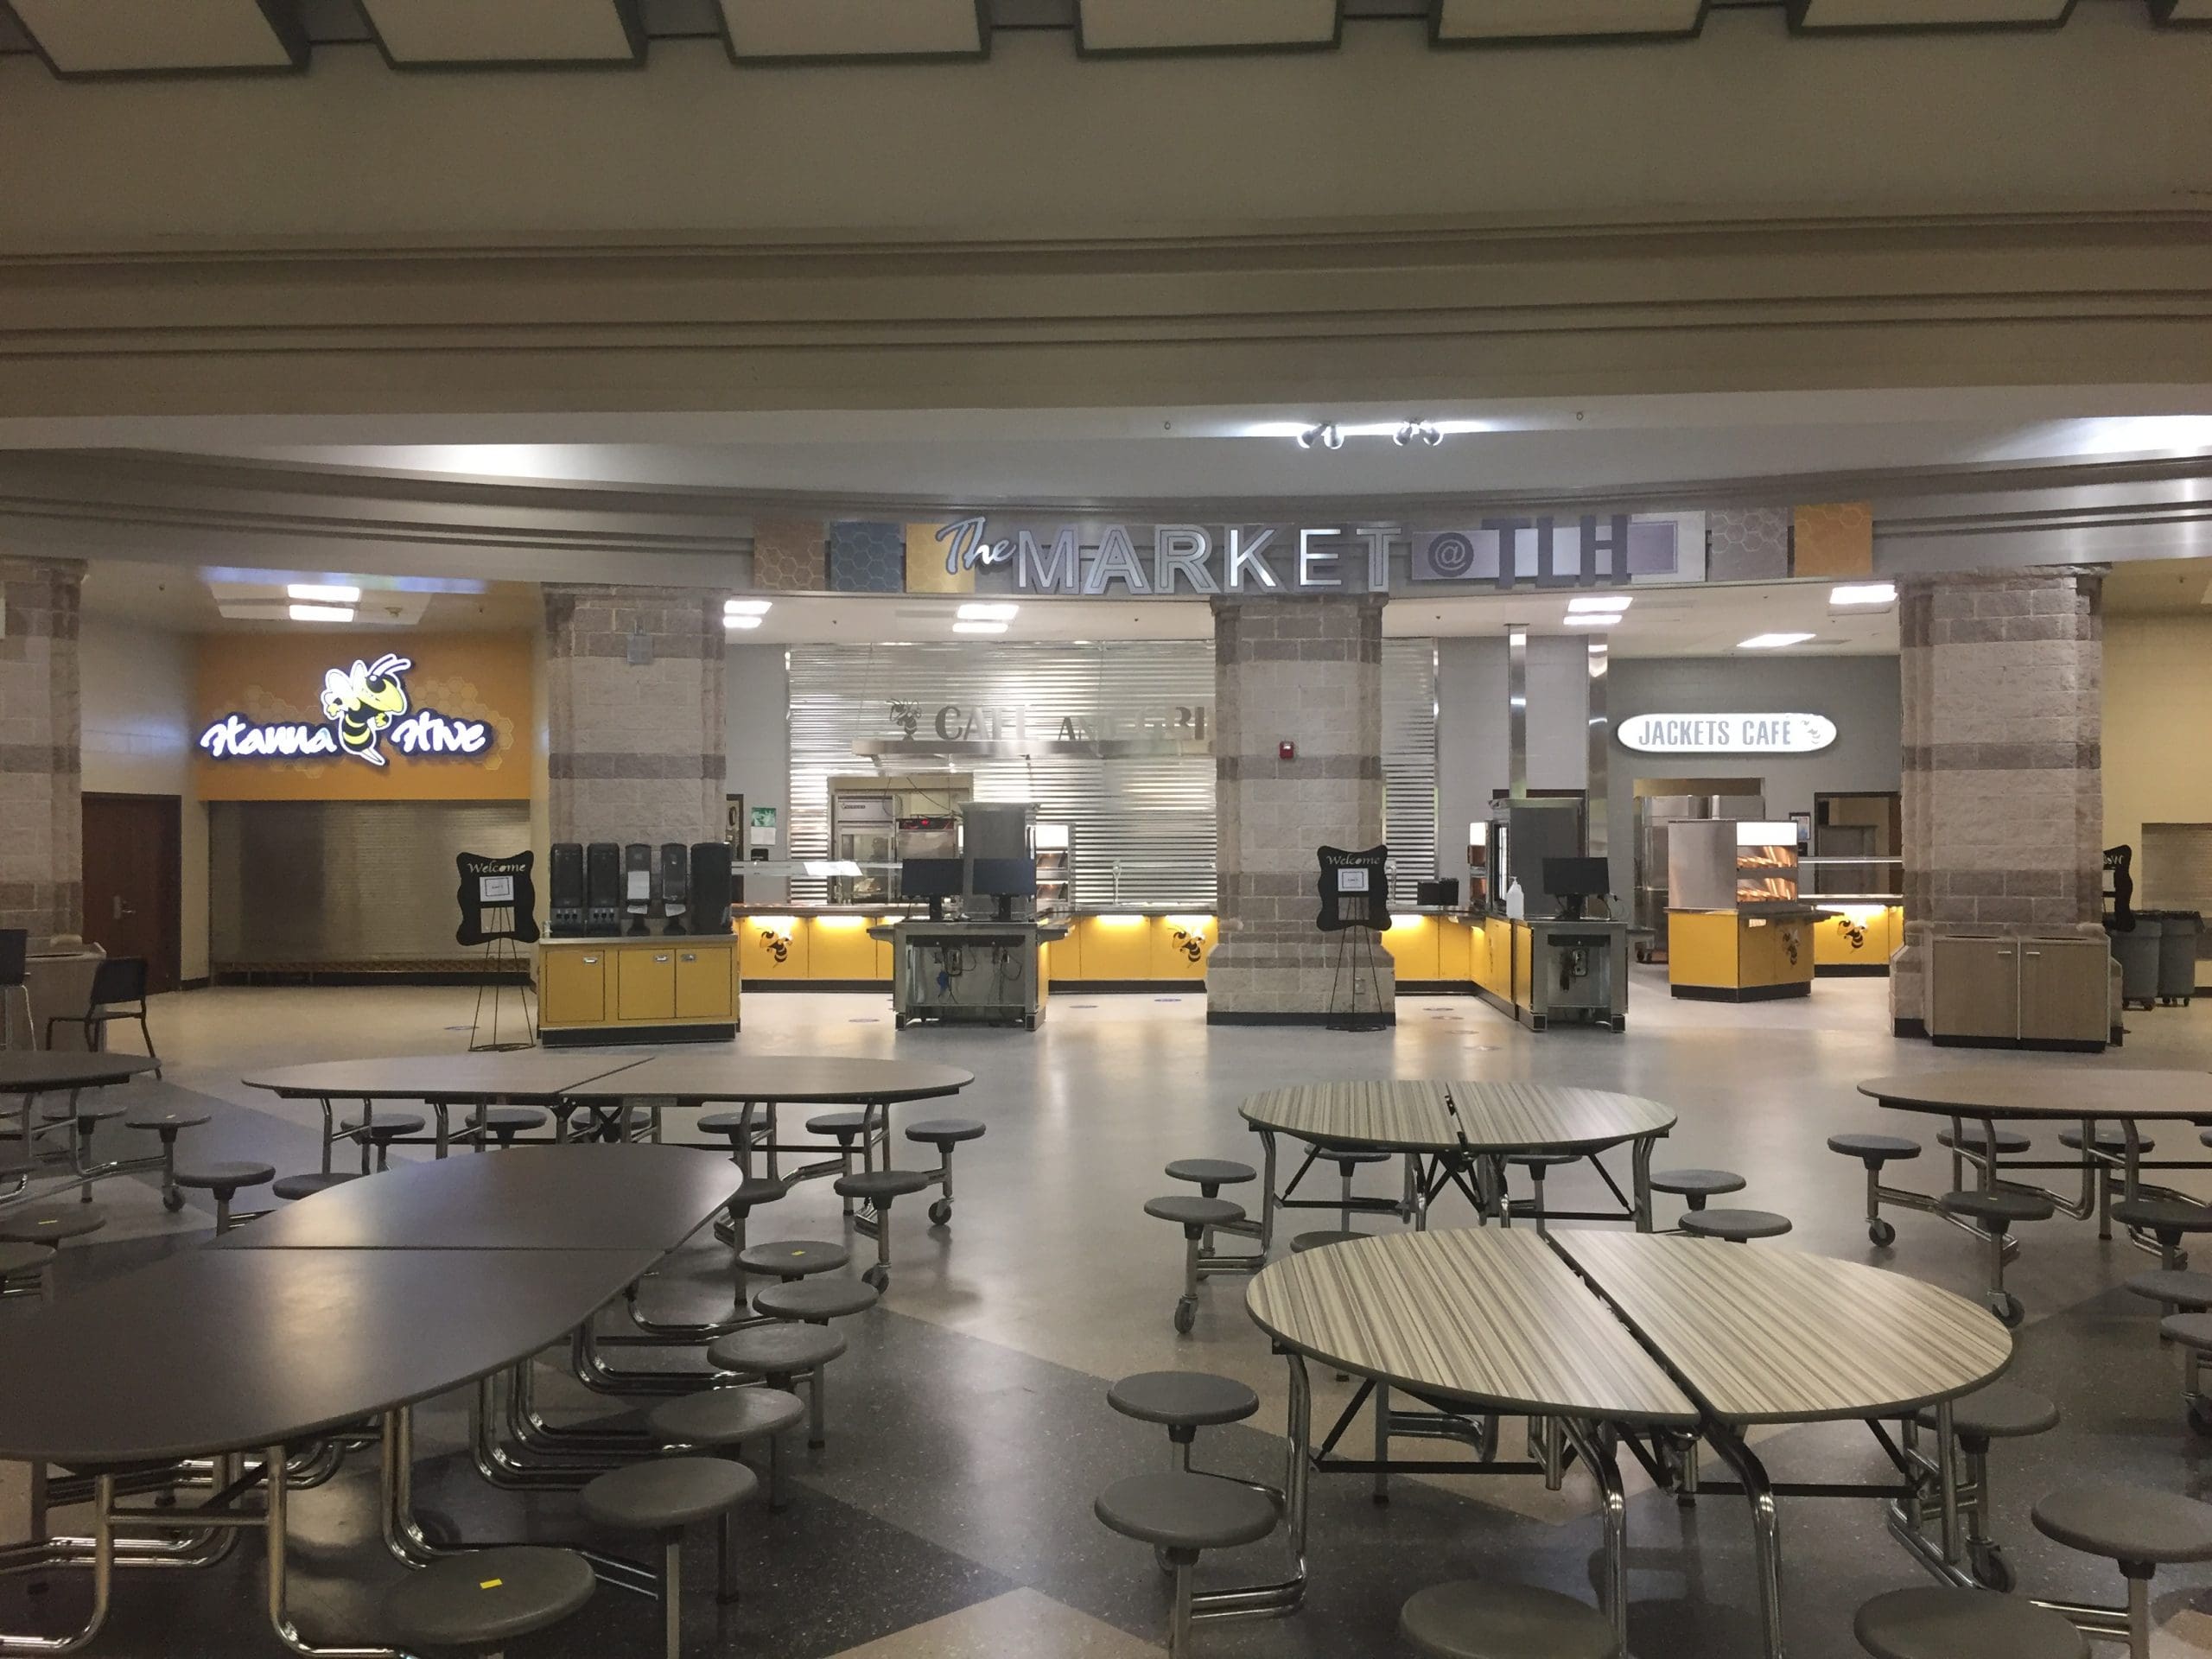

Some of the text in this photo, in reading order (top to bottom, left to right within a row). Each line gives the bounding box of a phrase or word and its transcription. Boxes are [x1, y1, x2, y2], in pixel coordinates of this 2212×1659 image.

[935, 516, 1016, 575] The
[1013, 522, 1403, 595] MARKET
[1433, 537, 1469, 574] @
[200, 710, 486, 757] Hanna Hive
[1638, 720, 1730, 746] JACKETS
[467, 860, 526, 874] Welcome
[1326, 853, 1381, 865] Welcome
